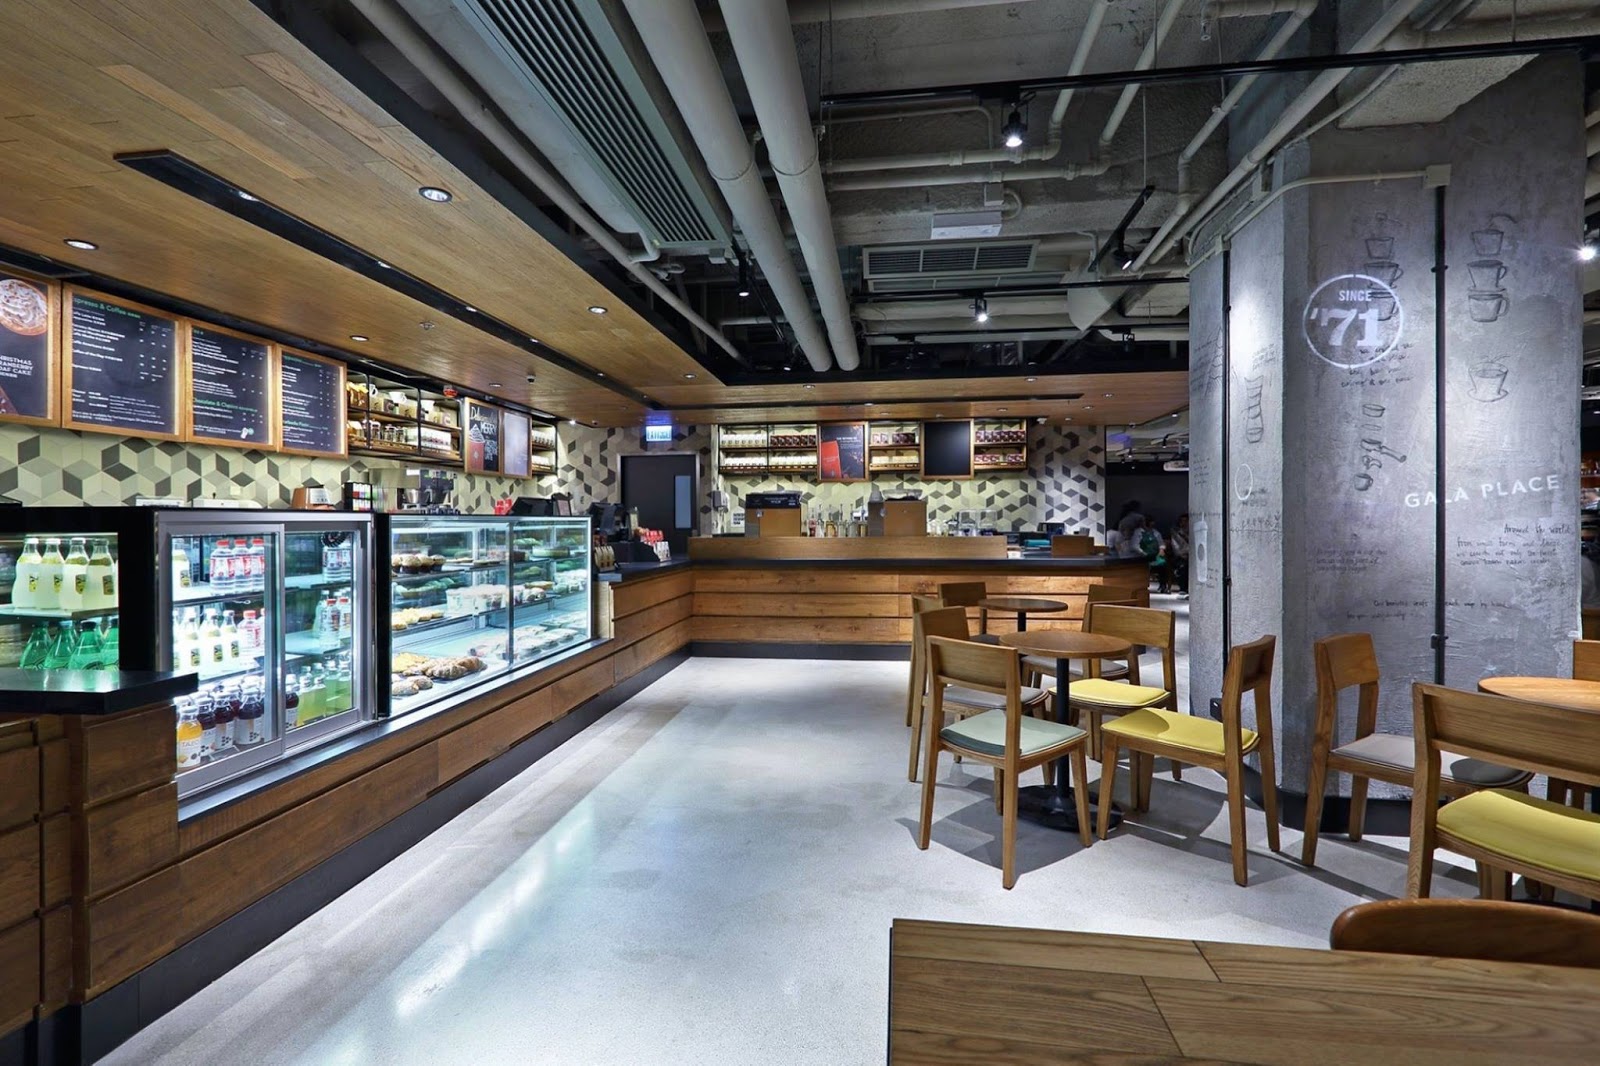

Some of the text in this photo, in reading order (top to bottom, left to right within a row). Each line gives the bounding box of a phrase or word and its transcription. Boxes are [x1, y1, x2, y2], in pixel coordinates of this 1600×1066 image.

[1338, 290, 1372, 302] SINCE
[1310, 307, 1384, 347] '71
[12, 368, 32, 376] CAKE
[1480, 474, 1560, 499] PLACE
